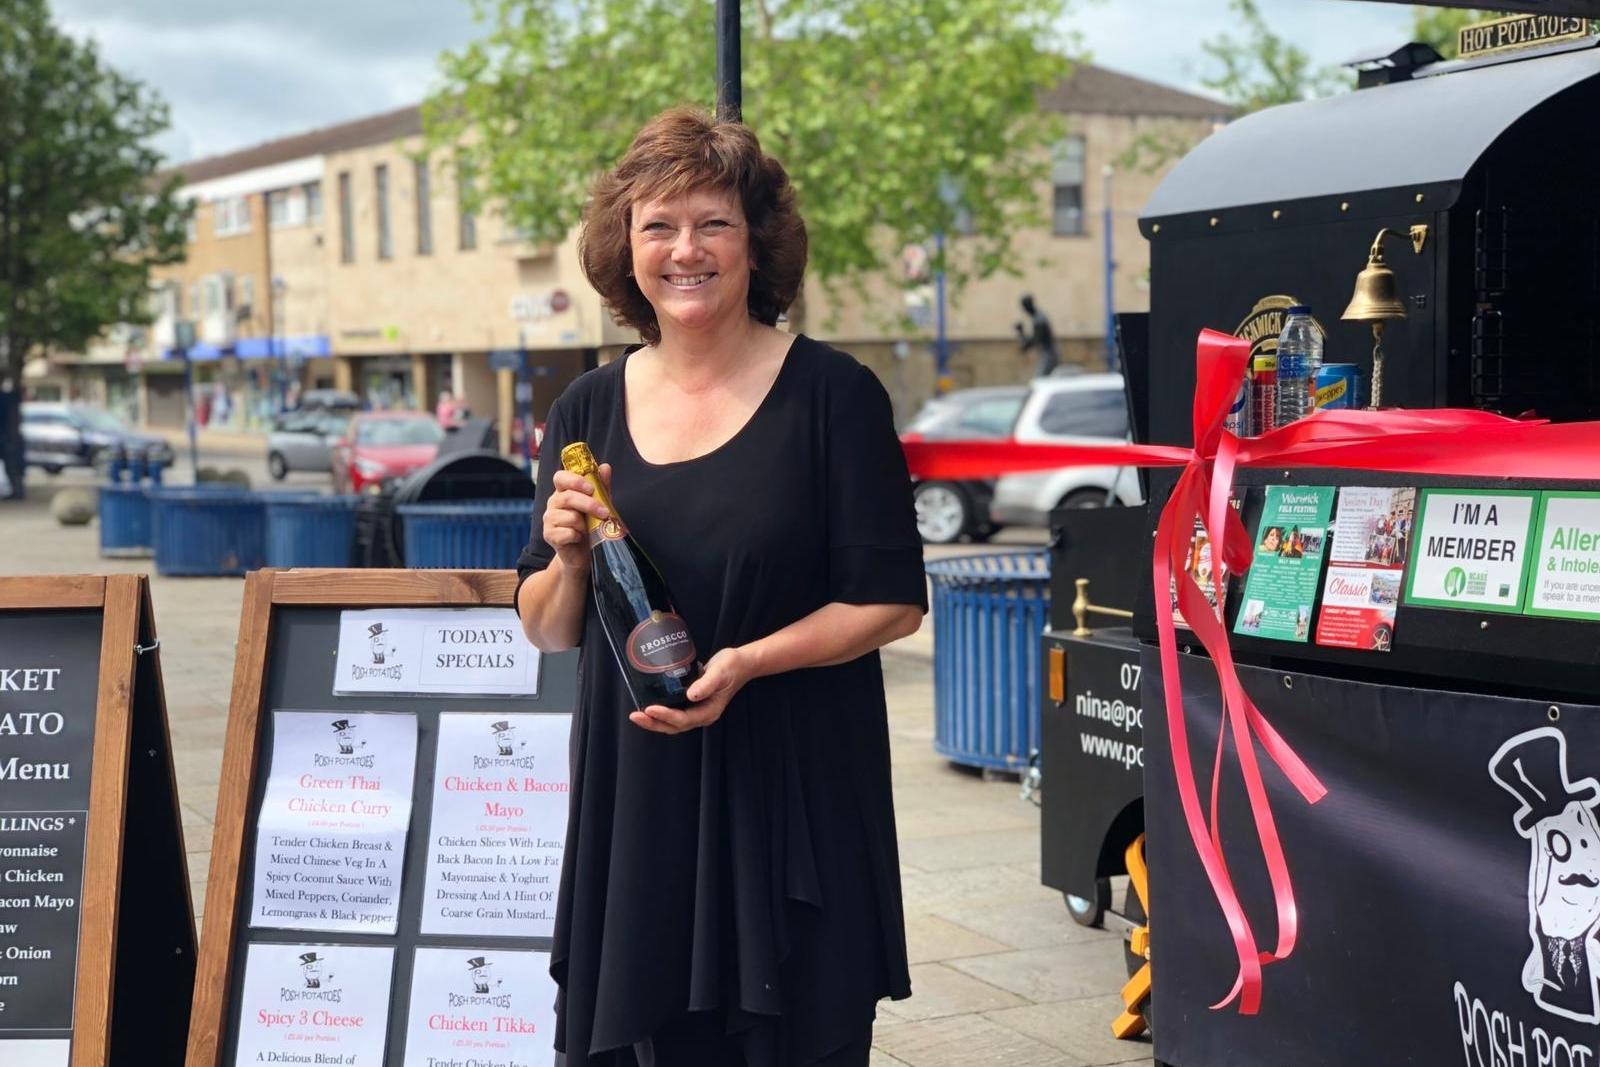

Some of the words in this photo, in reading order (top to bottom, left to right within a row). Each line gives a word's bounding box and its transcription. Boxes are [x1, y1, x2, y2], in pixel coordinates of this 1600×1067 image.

[1463, 27, 1494, 52] HOT
[1485, 504, 1498, 526] A
[1427, 536, 1516, 562] MEMBER
[1547, 556, 1556, 571] &
[1560, 557, 1600, 573] Intole
[640, 630, 687, 653] PROSECCO
[436, 653, 514, 668] SPECIALS
[0, 668, 61, 691] KET
[1120, 662, 1141, 691] 07
[0, 712, 64, 735] ATO
[0, 757, 70, 780] Menu
[495, 756, 535, 770] POTATOES
[300, 774, 343, 790] Green
[348, 775, 381, 791] Thai
[445, 776, 503, 792] Chicken
[506, 777, 519, 792] &
[524, 778, 568, 793] Bacon
[288, 798, 346, 814] Chicken
[351, 800, 392, 817] Curry
[484, 802, 524, 820] Mayo
[272, 836, 307, 848] Tender
[309, 838, 349, 850] Chicken
[352, 839, 382, 851] Breast
[384, 841, 393, 851] &
[438, 836, 477, 847] Chicken
[480, 837, 506, 848] Slices
[509, 838, 534, 848] With
[270, 854, 300, 865] Mixed
[303, 855, 341, 867] Chinese
[344, 857, 362, 869] Veg
[365, 857, 376, 868] In
[379, 858, 387, 869] A
[437, 854, 460, 865] Back
[463, 855, 493, 866] Bacon
[496, 855, 506, 866] In
[508, 855, 517, 866] A
[520, 856, 542, 866] Low
[544, 857, 559, 866] Fat
[5, 869, 64, 882] Chicken
[266, 871, 291, 884] Spicy
[294, 873, 334, 884] Coconut
[336, 874, 364, 886] Sauce
[367, 875, 392, 887] With
[441, 872, 497, 885] Mayonnaise
[499, 873, 507, 883] &
[511, 873, 549, 885] Yoghurt
[34, 895, 75, 911] Mayo
[265, 889, 295, 900] Mixed
[298, 890, 339, 904] Peppers,
[341, 892, 393, 906] Coriander,
[436, 889, 477, 902] Dressing
[479, 890, 500, 901] And
[503, 891, 512, 901] A
[514, 891, 537, 901] Hint
[539, 891, 554, 902] Of
[261, 906, 317, 920] Lemongrass
[320, 908, 328, 919] &
[331, 909, 358, 921] Black
[440, 907, 474, 919] Coarse
[476, 908, 504, 919] Grain
[6, 947, 52, 959] Onion
[302, 989, 342, 1003] POTATOES
[470, 994, 512, 1008] POTATOES
[257, 1008, 296, 1027] Spicy
[299, 1011, 308, 1026] 3
[312, 1011, 364, 1027] Cheese
[428, 1014, 488, 1032] Chicken
[493, 1016, 537, 1034] Tikka
[1453, 980, 1527, 1067] POSH
[256, 1051, 265, 1063] A
[267, 1051, 312, 1064] Delicious
[314, 1053, 345, 1065] Blend
[347, 1054, 357, 1066] of
[426, 1057, 463, 1067] Tender
